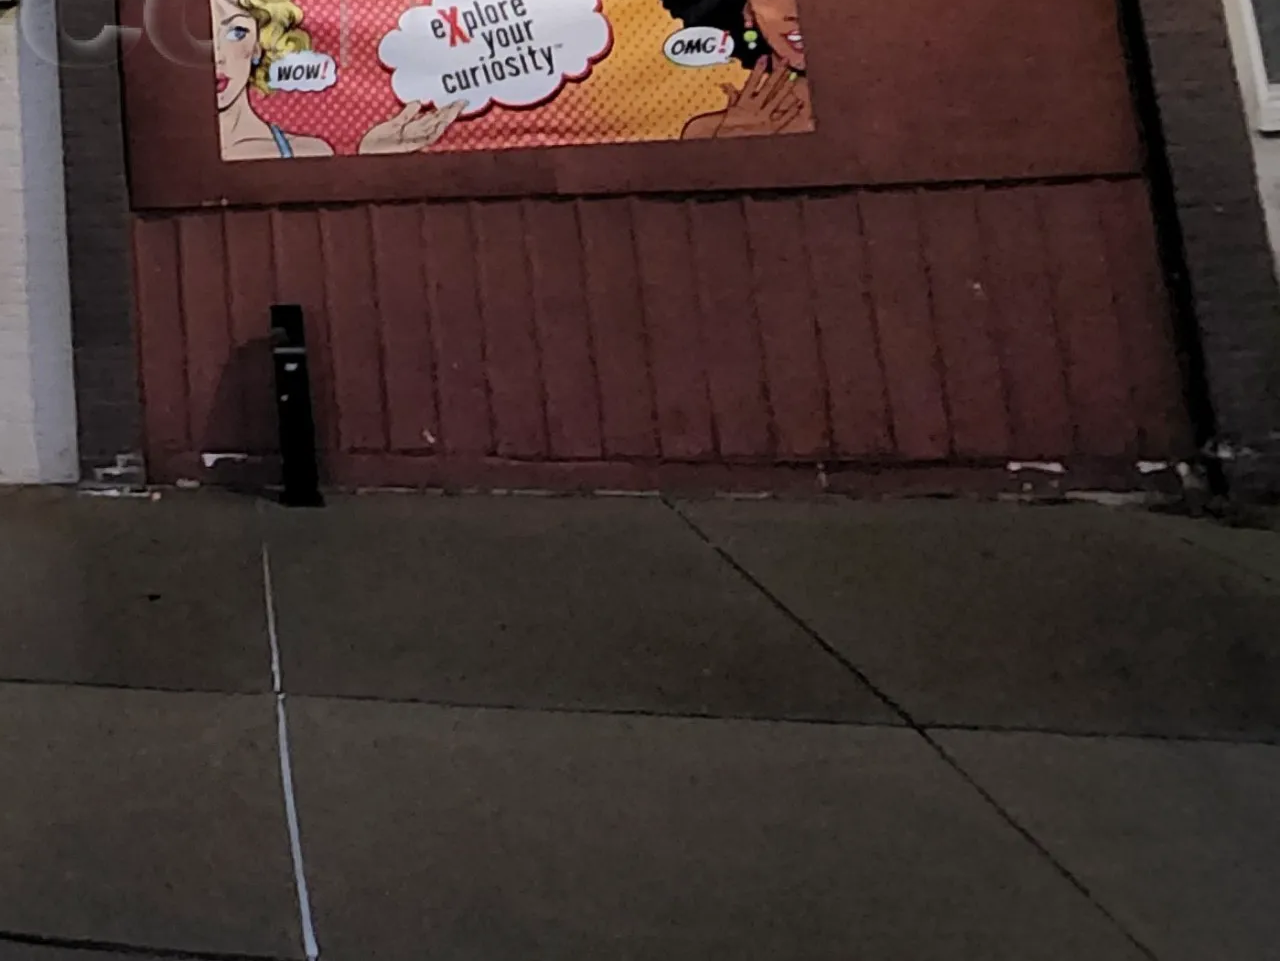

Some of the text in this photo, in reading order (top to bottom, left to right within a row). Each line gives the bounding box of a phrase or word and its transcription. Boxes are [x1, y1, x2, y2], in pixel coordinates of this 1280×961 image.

[481, 19, 534, 59] your
[671, 30, 730, 56] OMG!
[277, 59, 330, 82] WOW!
